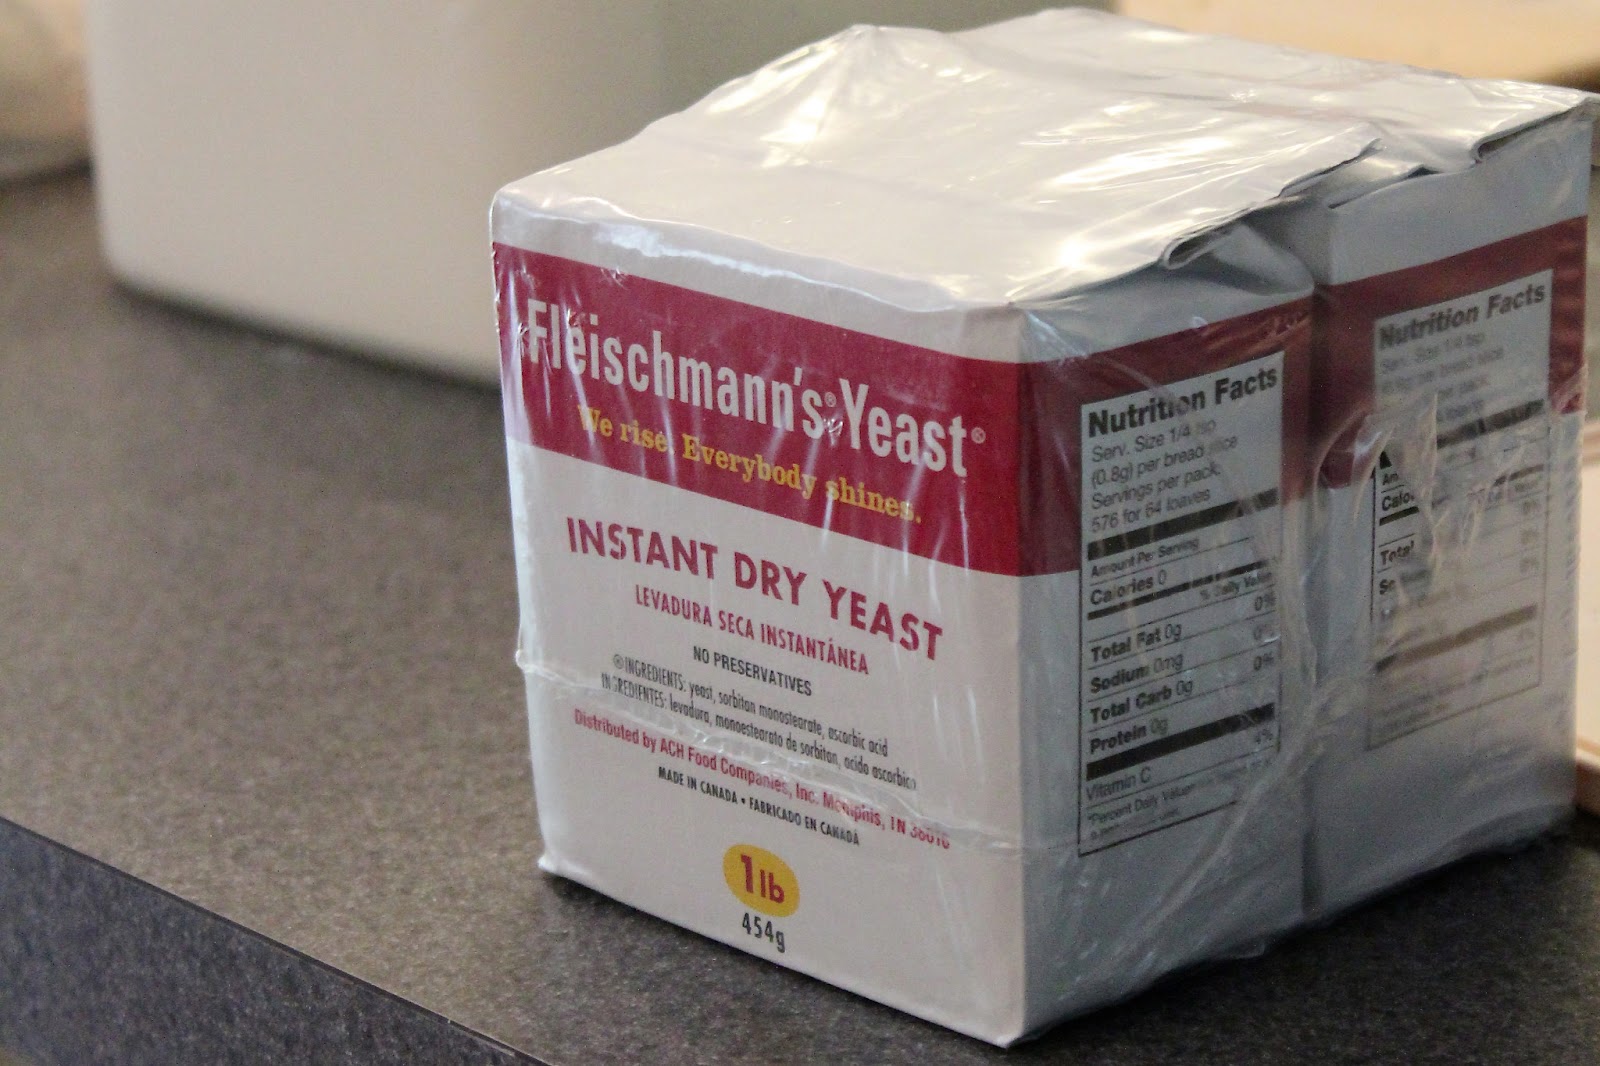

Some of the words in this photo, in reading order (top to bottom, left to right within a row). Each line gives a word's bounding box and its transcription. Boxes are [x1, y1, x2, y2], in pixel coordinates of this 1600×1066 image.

[1378, 305, 1480, 351] Nutrition
[1486, 283, 1546, 320] Facts
[526, 298, 825, 439] Fleischmann's
[839, 377, 968, 478] Yeast
[1088, 387, 1206, 438] Nutrition
[1214, 367, 1278, 405] Facts
[577, 404, 613, 437] We
[682, 433, 817, 500] Everybody
[825, 477, 923, 524] shines.
[1135, 432, 1165, 453] Size
[1136, 454, 1160, 479] per
[1091, 480, 1154, 511] Servings
[566, 516, 719, 580] INSTANT
[734, 551, 808, 606] DRY
[823, 579, 943, 661] YEAST
[635, 584, 713, 627] LEVADURA
[718, 610, 755, 641] SECA
[760, 623, 870, 675] INSTANTÁNEA
[1091, 636, 1132, 663] Total
[1136, 630, 1161, 653] Fat
[693, 645, 709, 664] NO
[714, 652, 812, 697] PRESERVATIVES
[1090, 664, 1150, 695] Sodium
[625, 656, 686, 693] INGREDIENTS:
[689, 681, 716, 704] yeast,
[718, 688, 756, 715] sorbitan
[759, 702, 826, 740] monostearate,
[828, 727, 865, 750] ascorbic
[868, 738, 889, 758] acid
[669, 693, 713, 728] levadura,
[786, 732, 798, 752] de
[800, 740, 841, 770] sorbitan,
[1091, 697, 1131, 724] Total
[574, 708, 640, 745] Distributed
[642, 731, 657, 754] by
[660, 738, 685, 761] ACH
[688, 747, 717, 771] Food
[720, 757, 793, 799] Companies,
[1090, 724, 1147, 756] Protein
[658, 766, 684, 786] MADE
[687, 776, 697, 791] IN
[700, 781, 738, 805] CANADA
[749, 796, 802, 827] FABRICADO
[804, 816, 817, 832] EN
[740, 853, 754, 894] 1
[760, 868, 785, 904] lb
[742, 912, 786, 954] 454g
